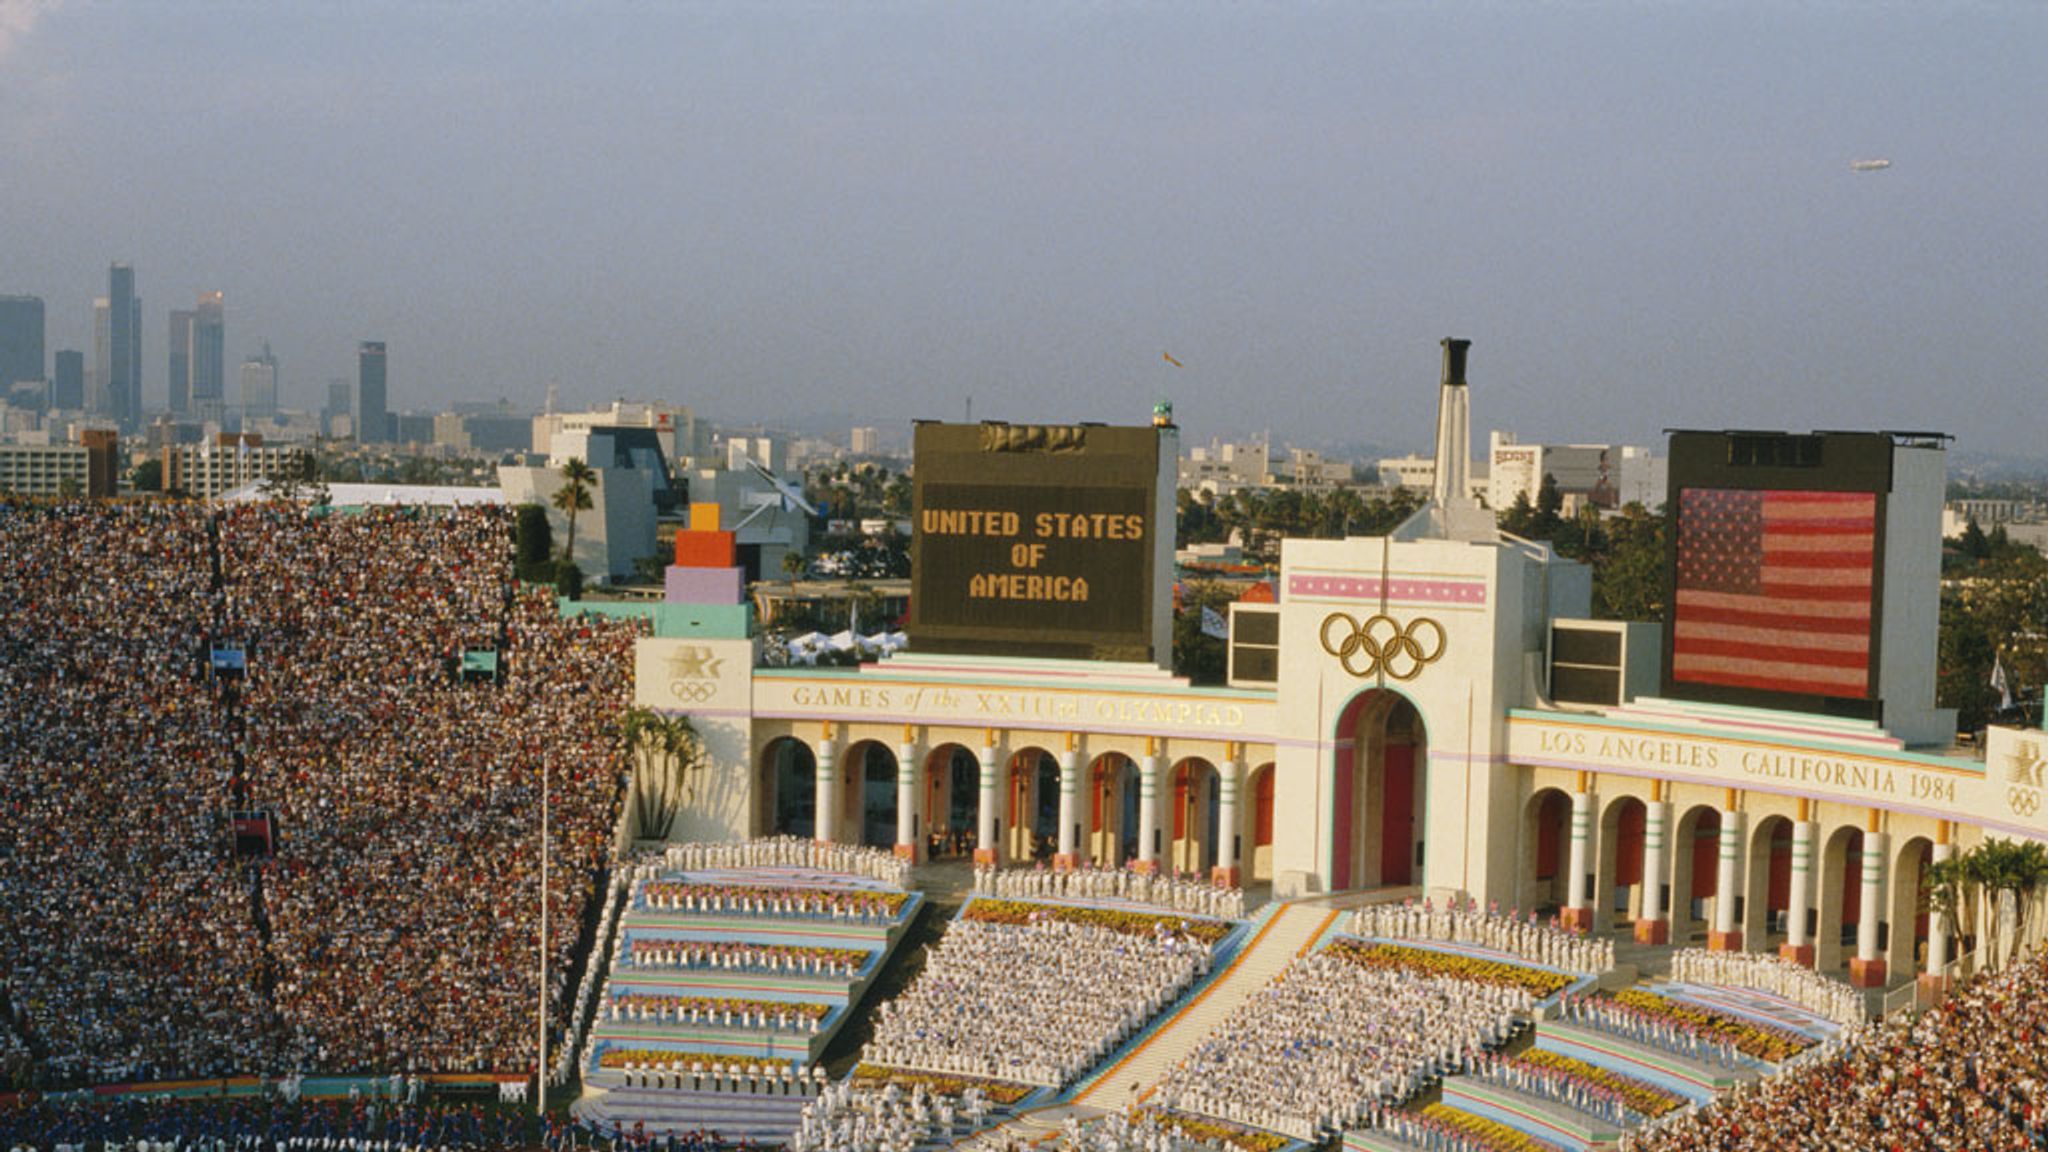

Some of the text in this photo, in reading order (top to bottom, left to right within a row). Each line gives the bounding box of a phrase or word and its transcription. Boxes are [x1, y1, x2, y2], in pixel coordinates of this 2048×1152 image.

[922, 510, 1143, 539] UNITED STATES
[1011, 544, 1046, 568] OF
[969, 574, 1089, 600] AMERICA
[792, 686, 891, 707] GAMES
[904, 687, 925, 711] of
[934, 688, 960, 708] the
[1096, 699, 1242, 726] OLYMPIAD
[1540, 730, 1956, 801] LOS ANGELES CALIFORNIA 1984
